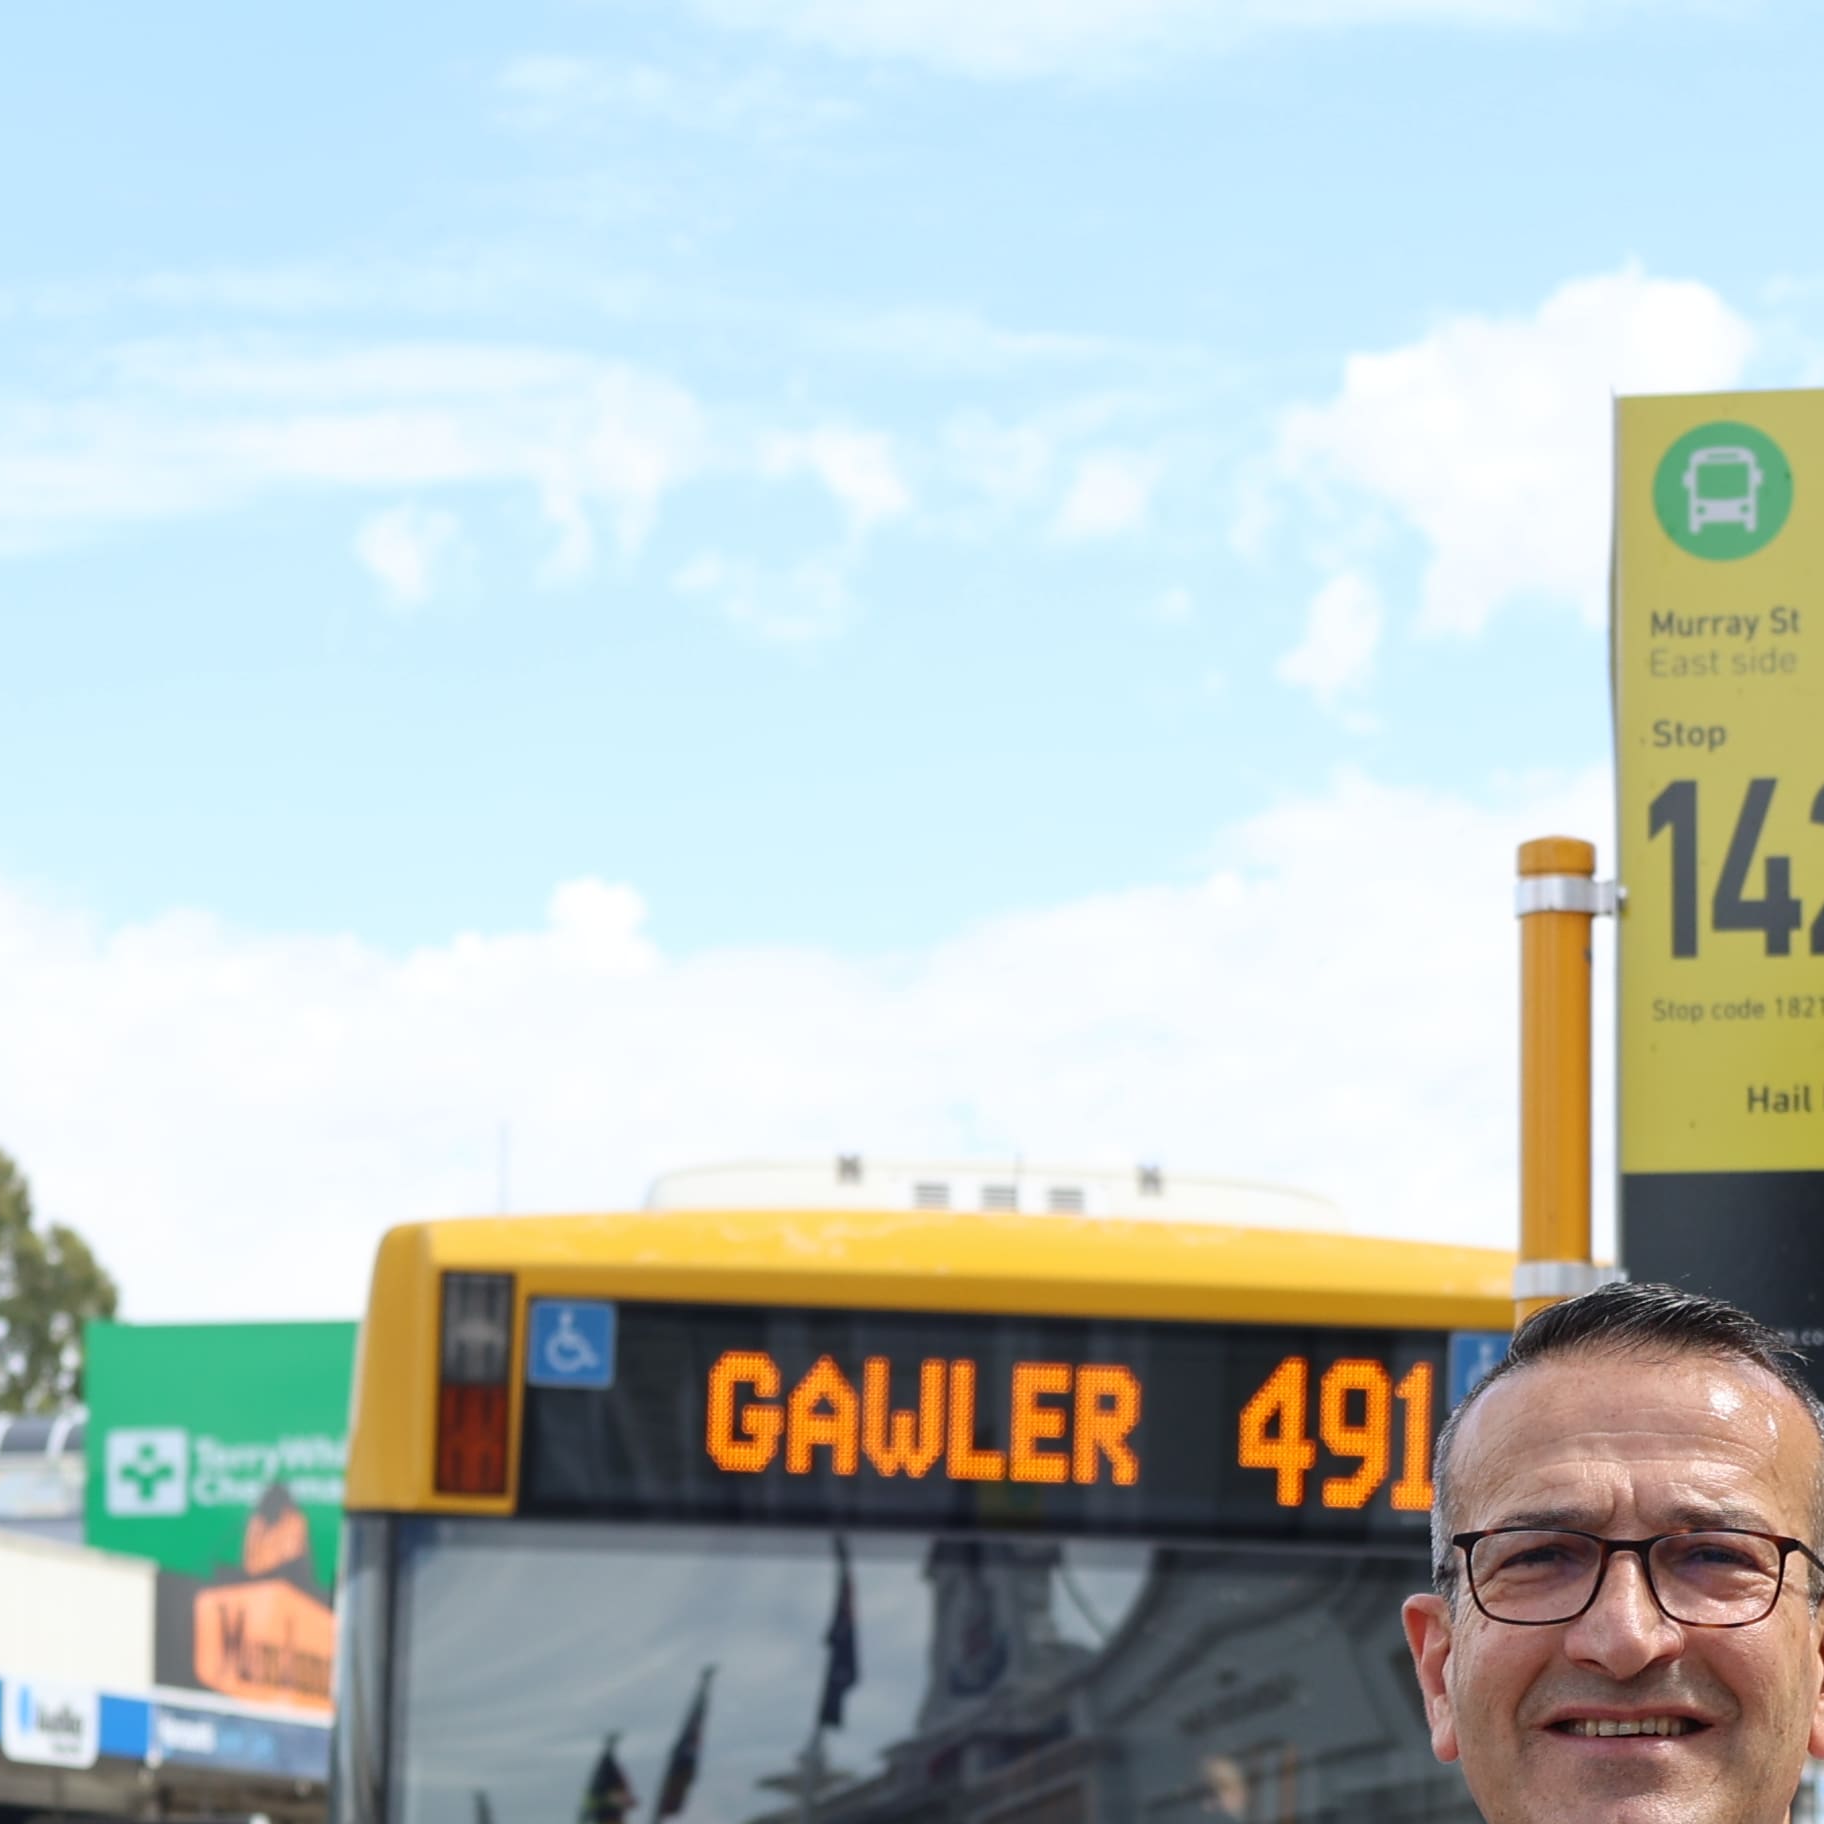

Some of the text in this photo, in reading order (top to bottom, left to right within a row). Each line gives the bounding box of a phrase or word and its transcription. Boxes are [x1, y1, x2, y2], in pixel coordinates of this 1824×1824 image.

[1650, 606, 1800, 641] Murray St
[1649, 647, 1798, 678] East side
[1652, 720, 1727, 752] Stop
[1652, 998, 1704, 1023] Stop
[1712, 998, 1766, 1020] code
[1746, 1086, 1812, 1113] Hail
[706, 1349, 1435, 1511] GAWLER 491
